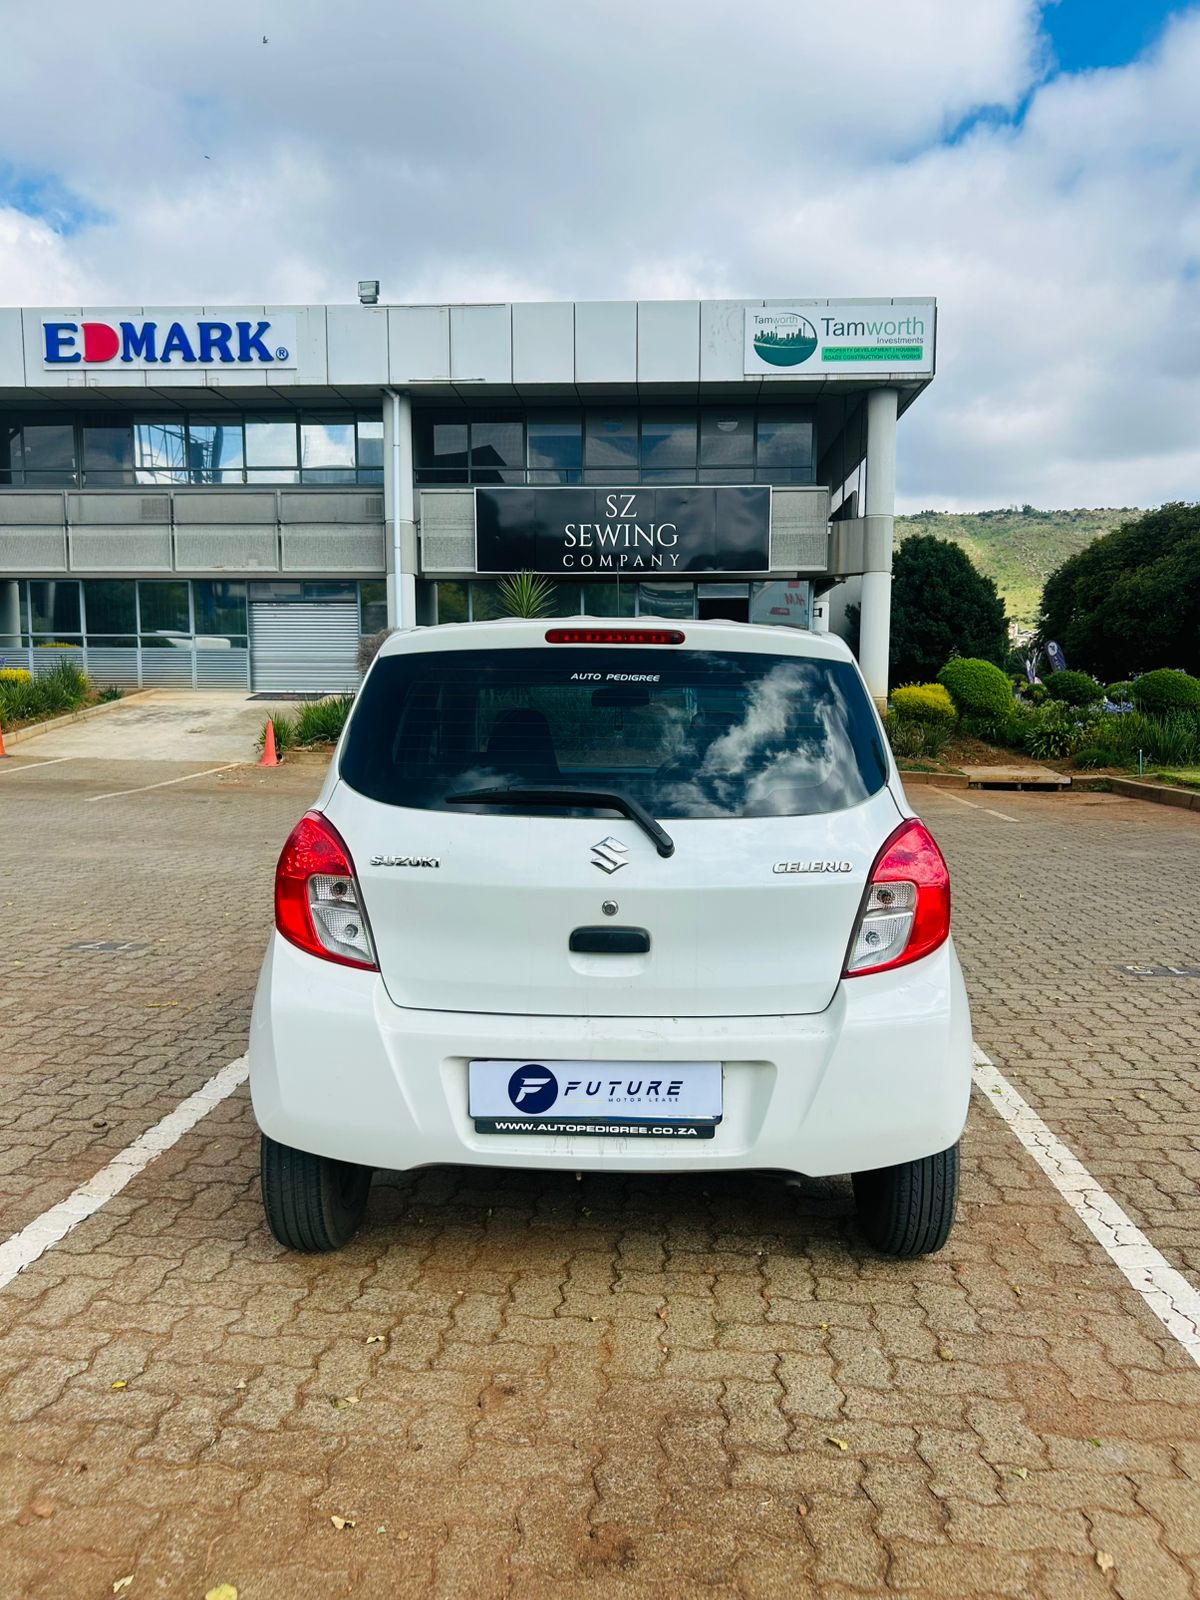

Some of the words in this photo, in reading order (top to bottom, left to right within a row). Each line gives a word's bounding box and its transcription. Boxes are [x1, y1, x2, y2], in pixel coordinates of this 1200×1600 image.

[753, 315, 799, 325] Tamworth
[821, 316, 924, 336] Tamworth
[605, 494, 638, 518] SZ
[564, 523, 679, 547] SEWING
[562, 554, 680, 567] COMPANY
[606, 673, 661, 682] PEDIGREE
[369, 854, 441, 868] SUZUKI
[772, 860, 854, 873] CELERIO
[564, 1080, 684, 1096] FUTURE
[495, 1121, 698, 1135] WWW.AUTOPEDIGREE.CO.ZA
